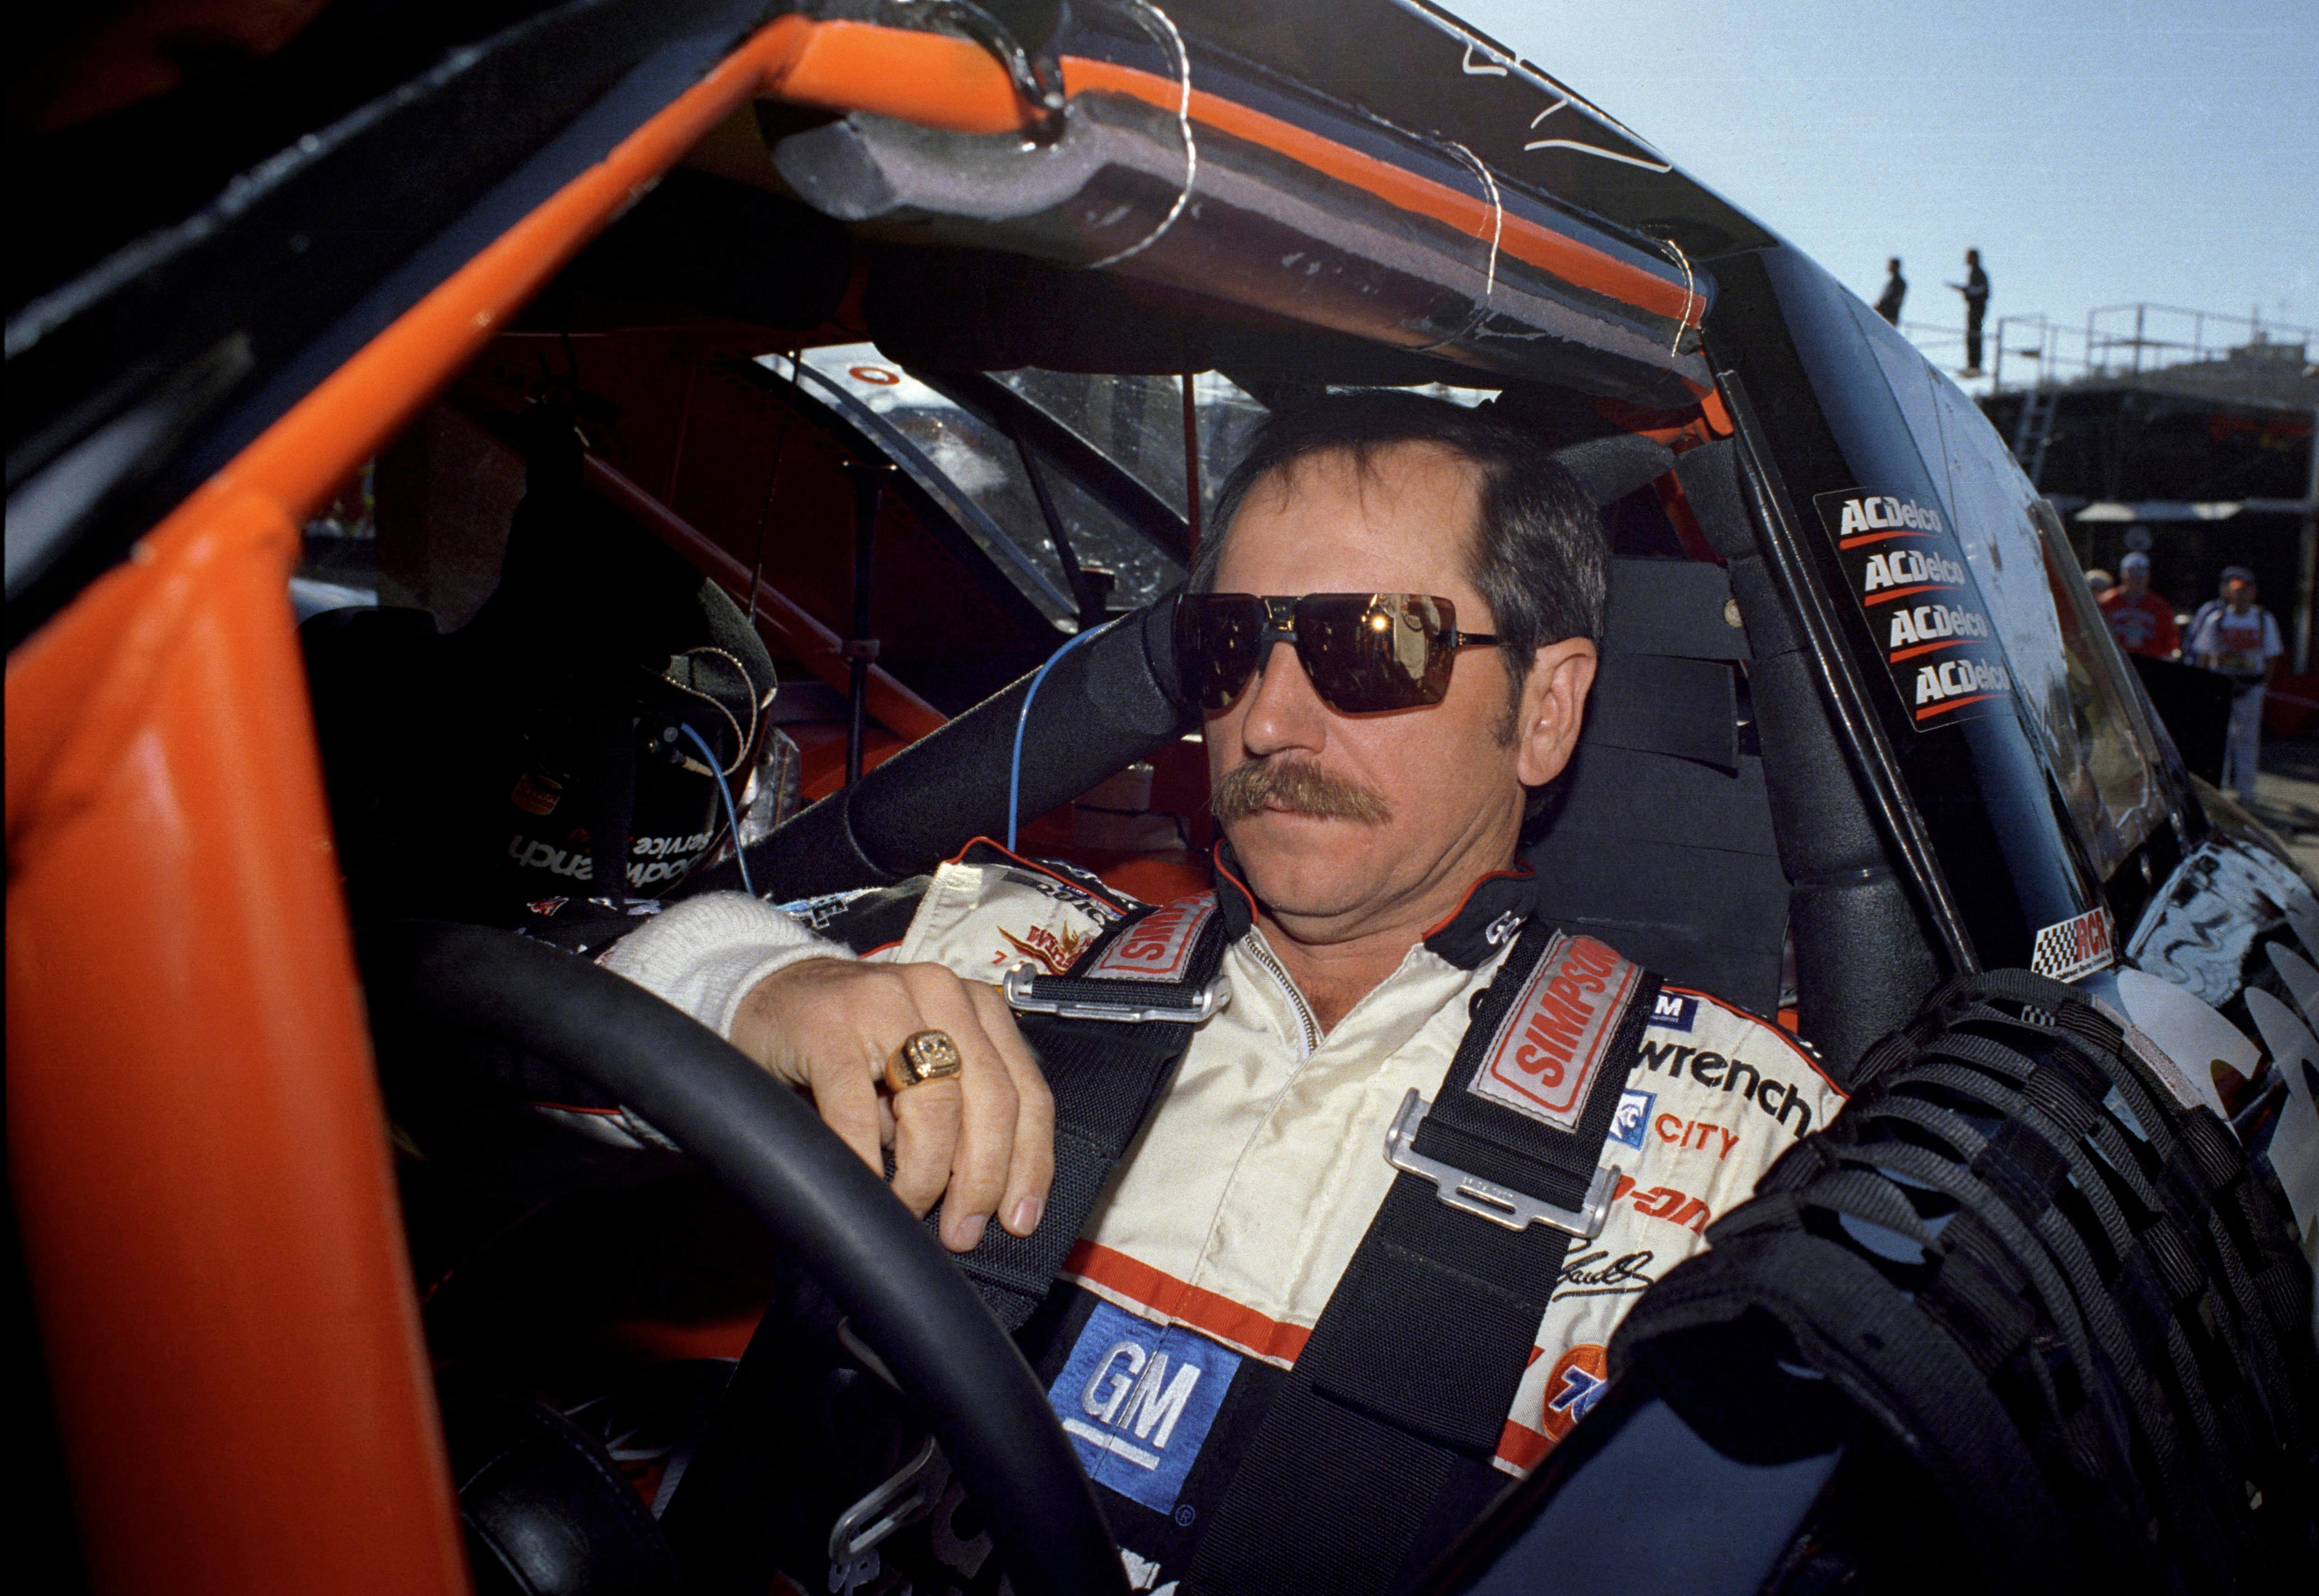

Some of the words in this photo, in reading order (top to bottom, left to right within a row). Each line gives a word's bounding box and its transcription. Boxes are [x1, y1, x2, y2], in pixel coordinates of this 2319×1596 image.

[1841, 496, 1943, 536] ACDelco
[1865, 550, 1965, 592] ACDelco
[1890, 604, 1988, 648] ACDelco
[1916, 658, 2011, 705] ACDelco
[2077, 911, 2108, 962] RCR
[1516, 936, 1621, 1088] SIMPSON
[1655, 1113, 1739, 1160] CITY
[1081, 1341, 1201, 1449] GM
